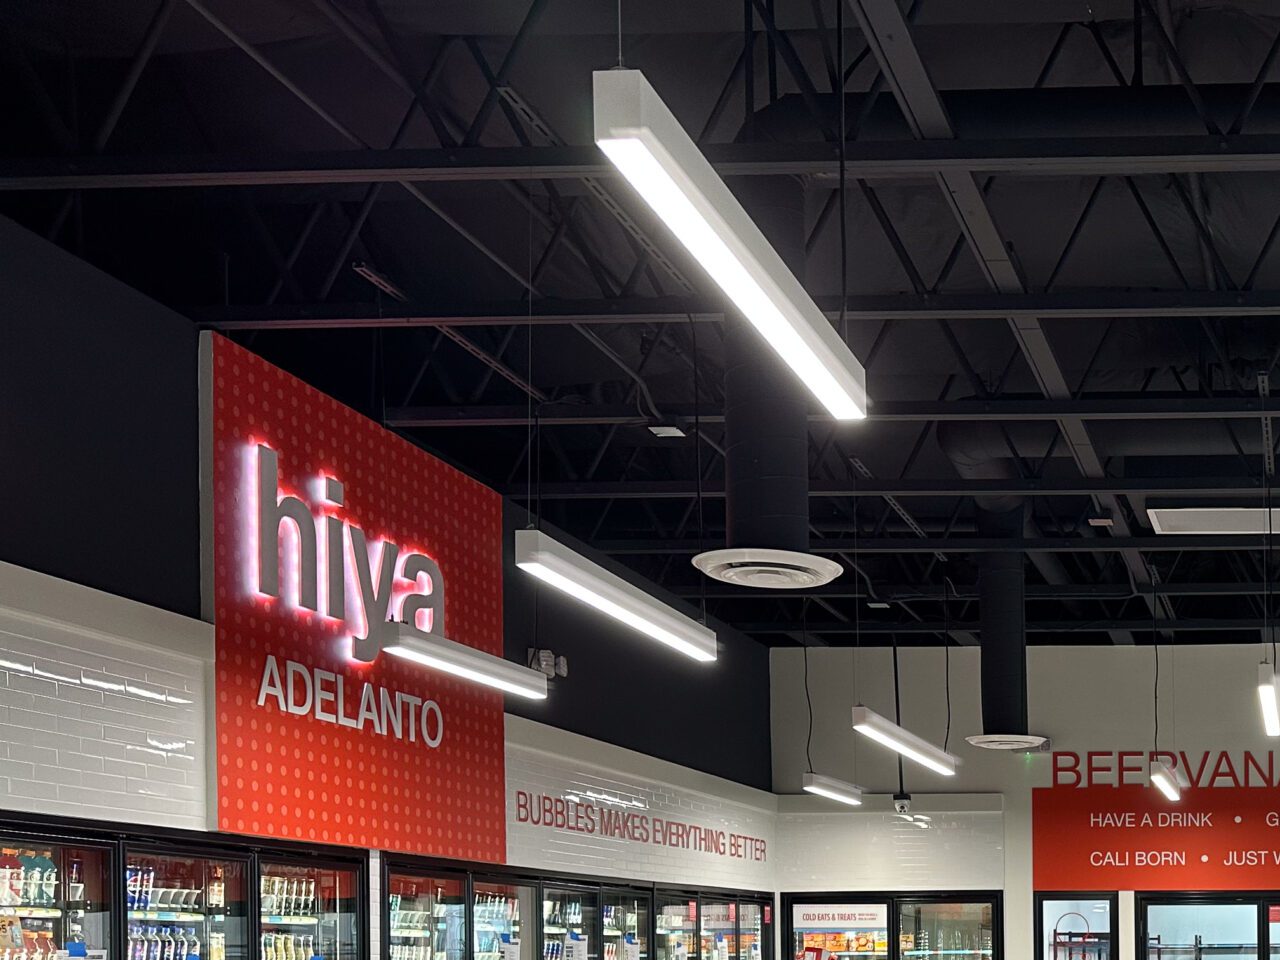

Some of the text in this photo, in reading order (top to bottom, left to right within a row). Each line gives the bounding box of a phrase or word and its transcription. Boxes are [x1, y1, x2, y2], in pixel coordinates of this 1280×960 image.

[256, 444, 444, 662] hiya
[258, 655, 444, 748] ADELANTO
[516, 790, 767, 863] BUBBLES MAKES EVERYTHING BETTER
[1090, 813, 1136, 827] HAVE
[1140, 813, 1152, 827] A
[1158, 813, 1213, 827] DRINK
[1090, 851, 1129, 866] CALI
[1135, 851, 1186, 866] BORN
[1224, 851, 1268, 866] JUST
